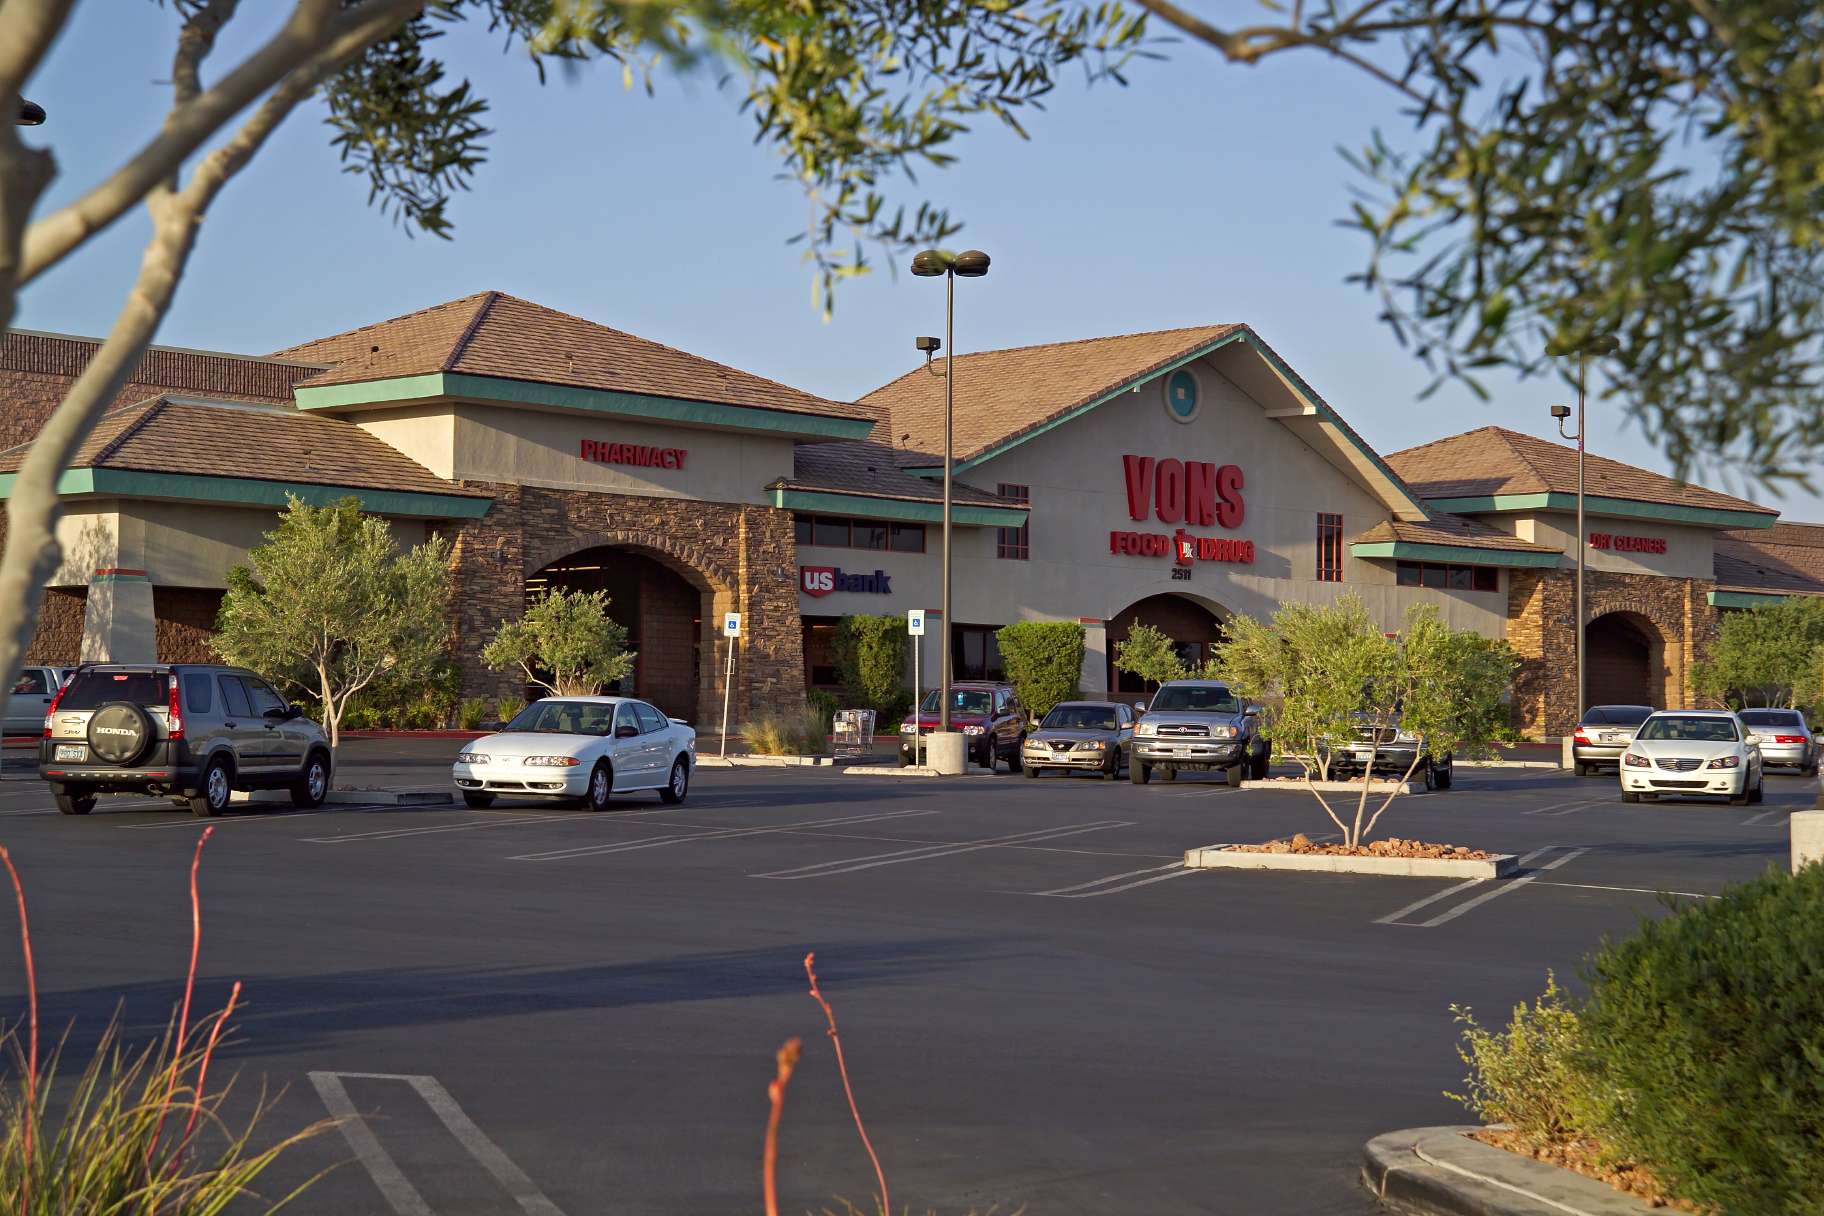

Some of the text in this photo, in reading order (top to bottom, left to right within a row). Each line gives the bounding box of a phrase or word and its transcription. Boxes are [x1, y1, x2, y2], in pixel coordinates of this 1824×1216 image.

[580, 439, 688, 470] PHARMACY
[1122, 454, 1245, 529] VONS
[1109, 530, 1170, 557] FOOD
[1196, 537, 1255, 565] DRUG
[834, 567, 893, 594] bank
[1171, 567, 1192, 581] 2511
[96, 726, 138, 737] HONDA
